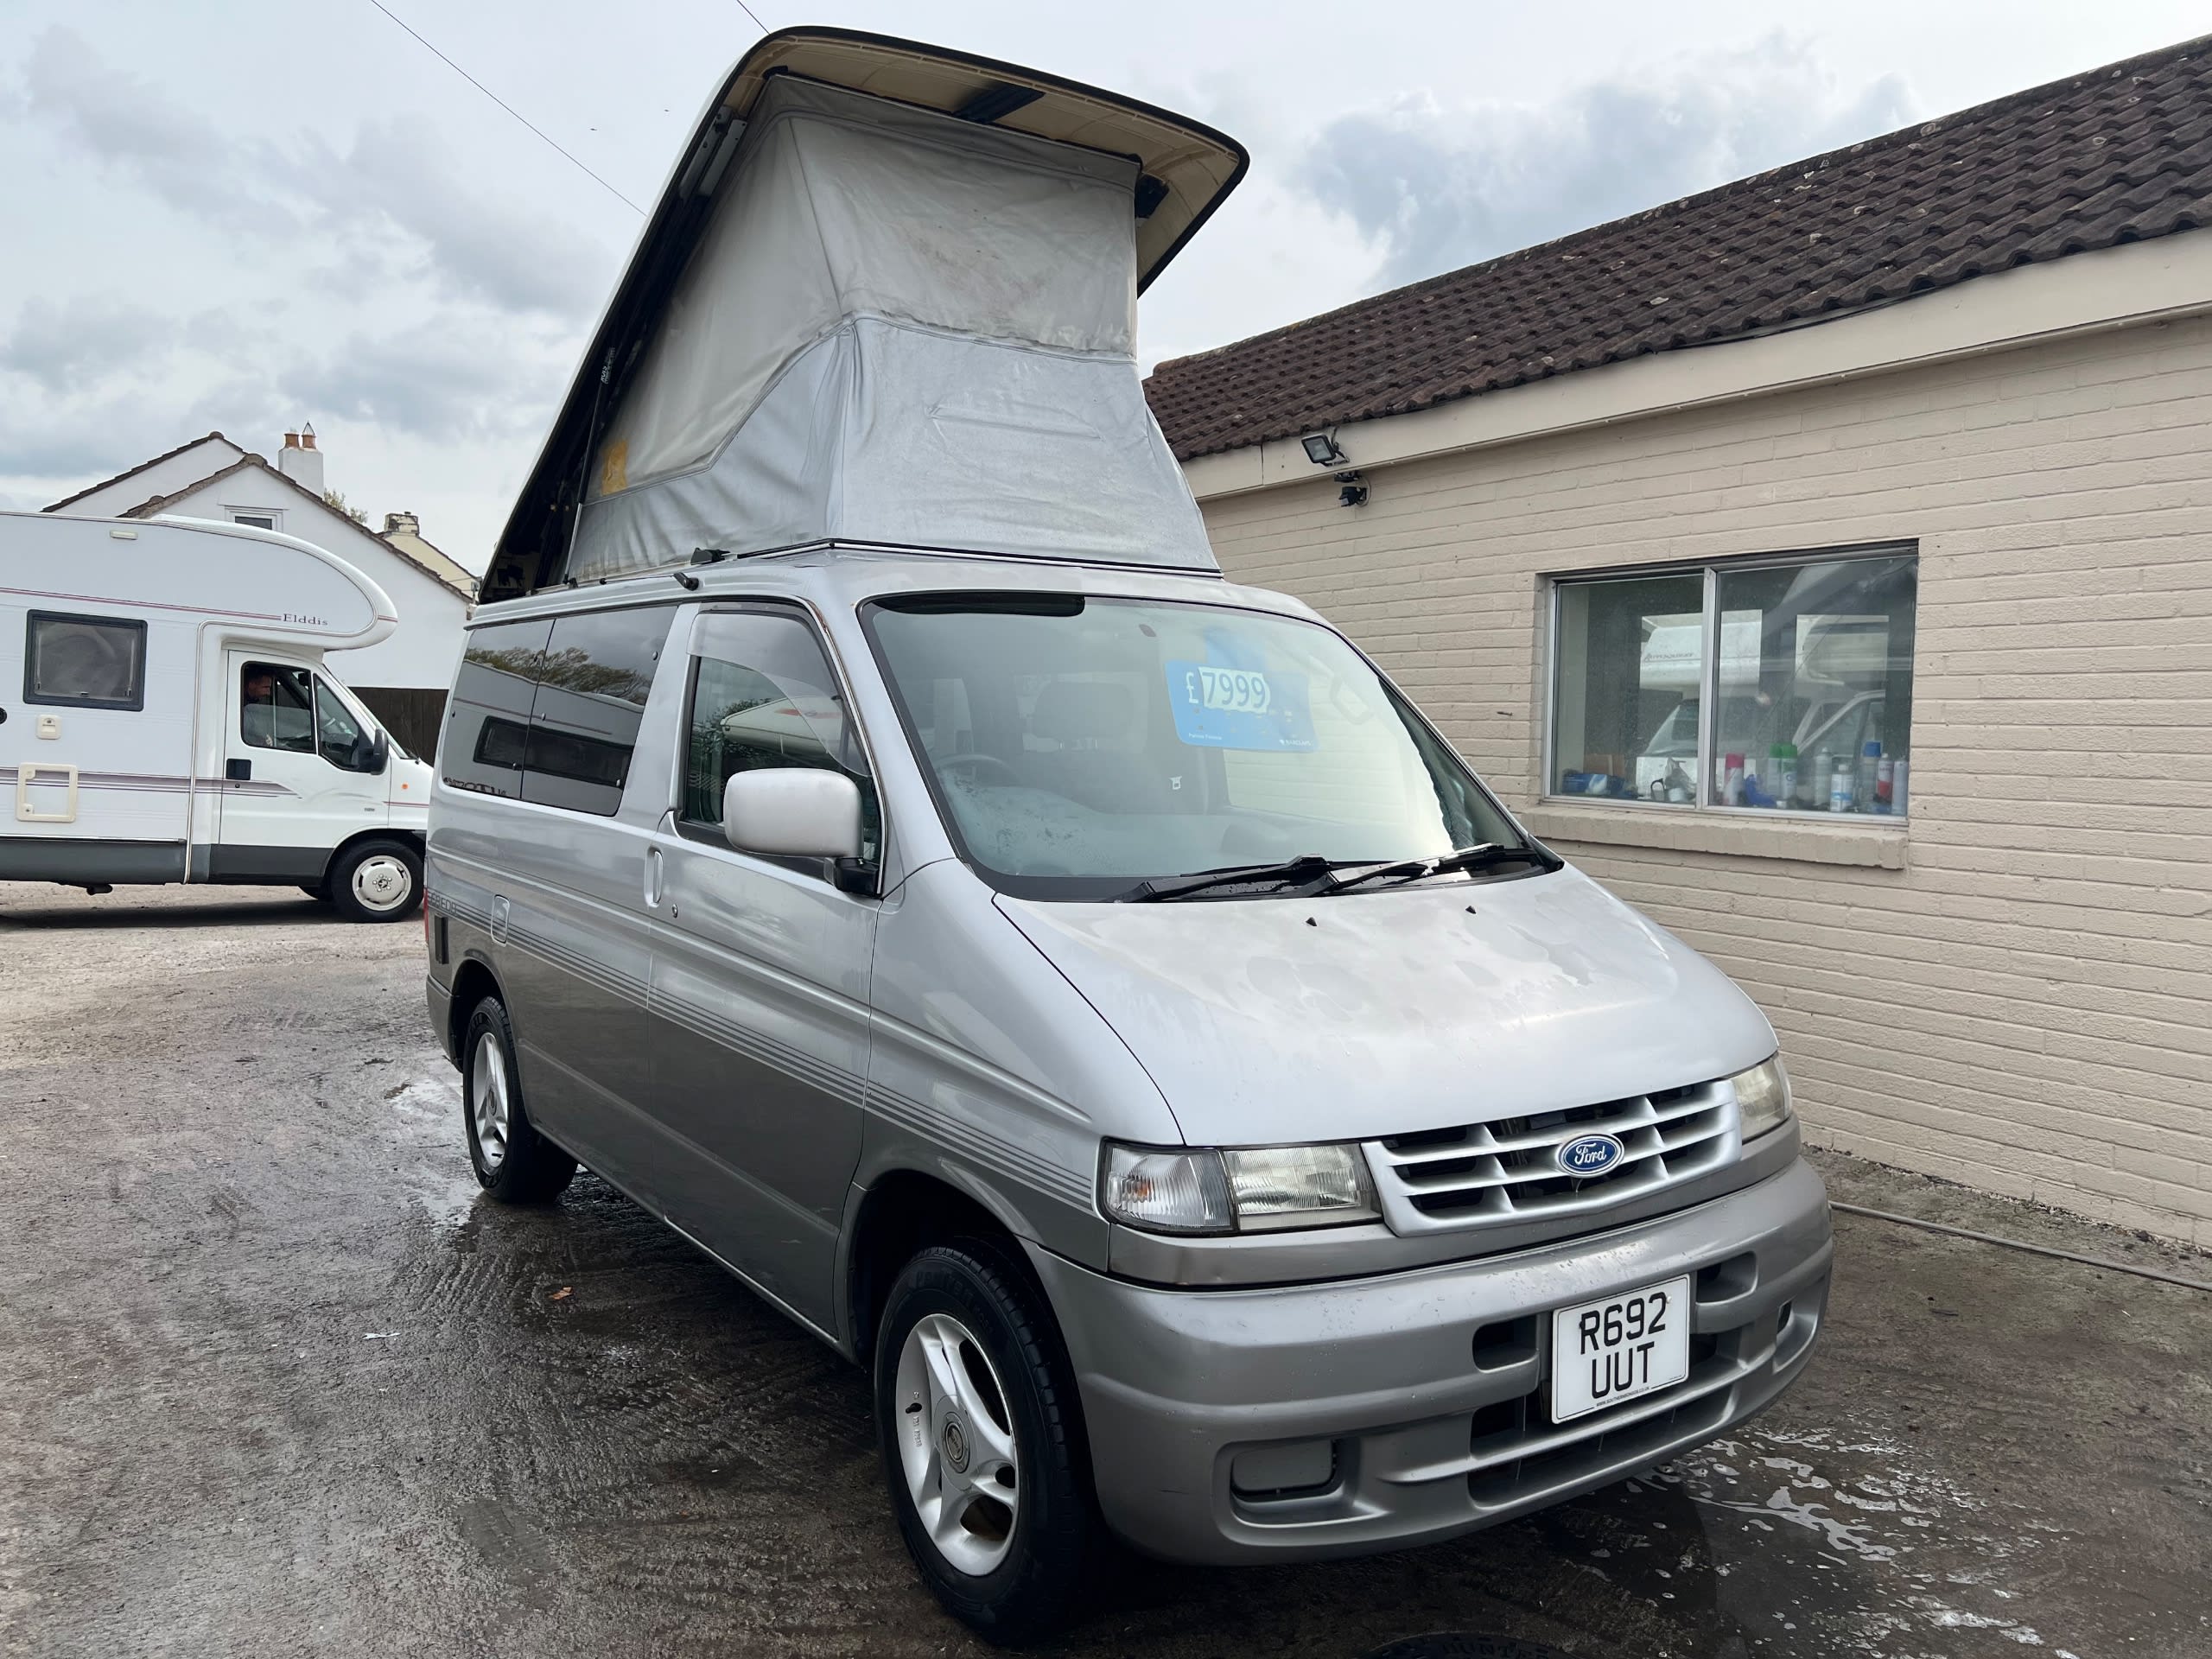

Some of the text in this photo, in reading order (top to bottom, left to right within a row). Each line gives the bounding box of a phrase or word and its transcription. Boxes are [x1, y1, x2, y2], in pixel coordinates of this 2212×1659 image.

[283, 613, 329, 626] Elddis
[1573, 1142, 1607, 1166] Ford
[1580, 1291, 1667, 1355] R692
[1592, 1340, 1656, 1399] UUT
